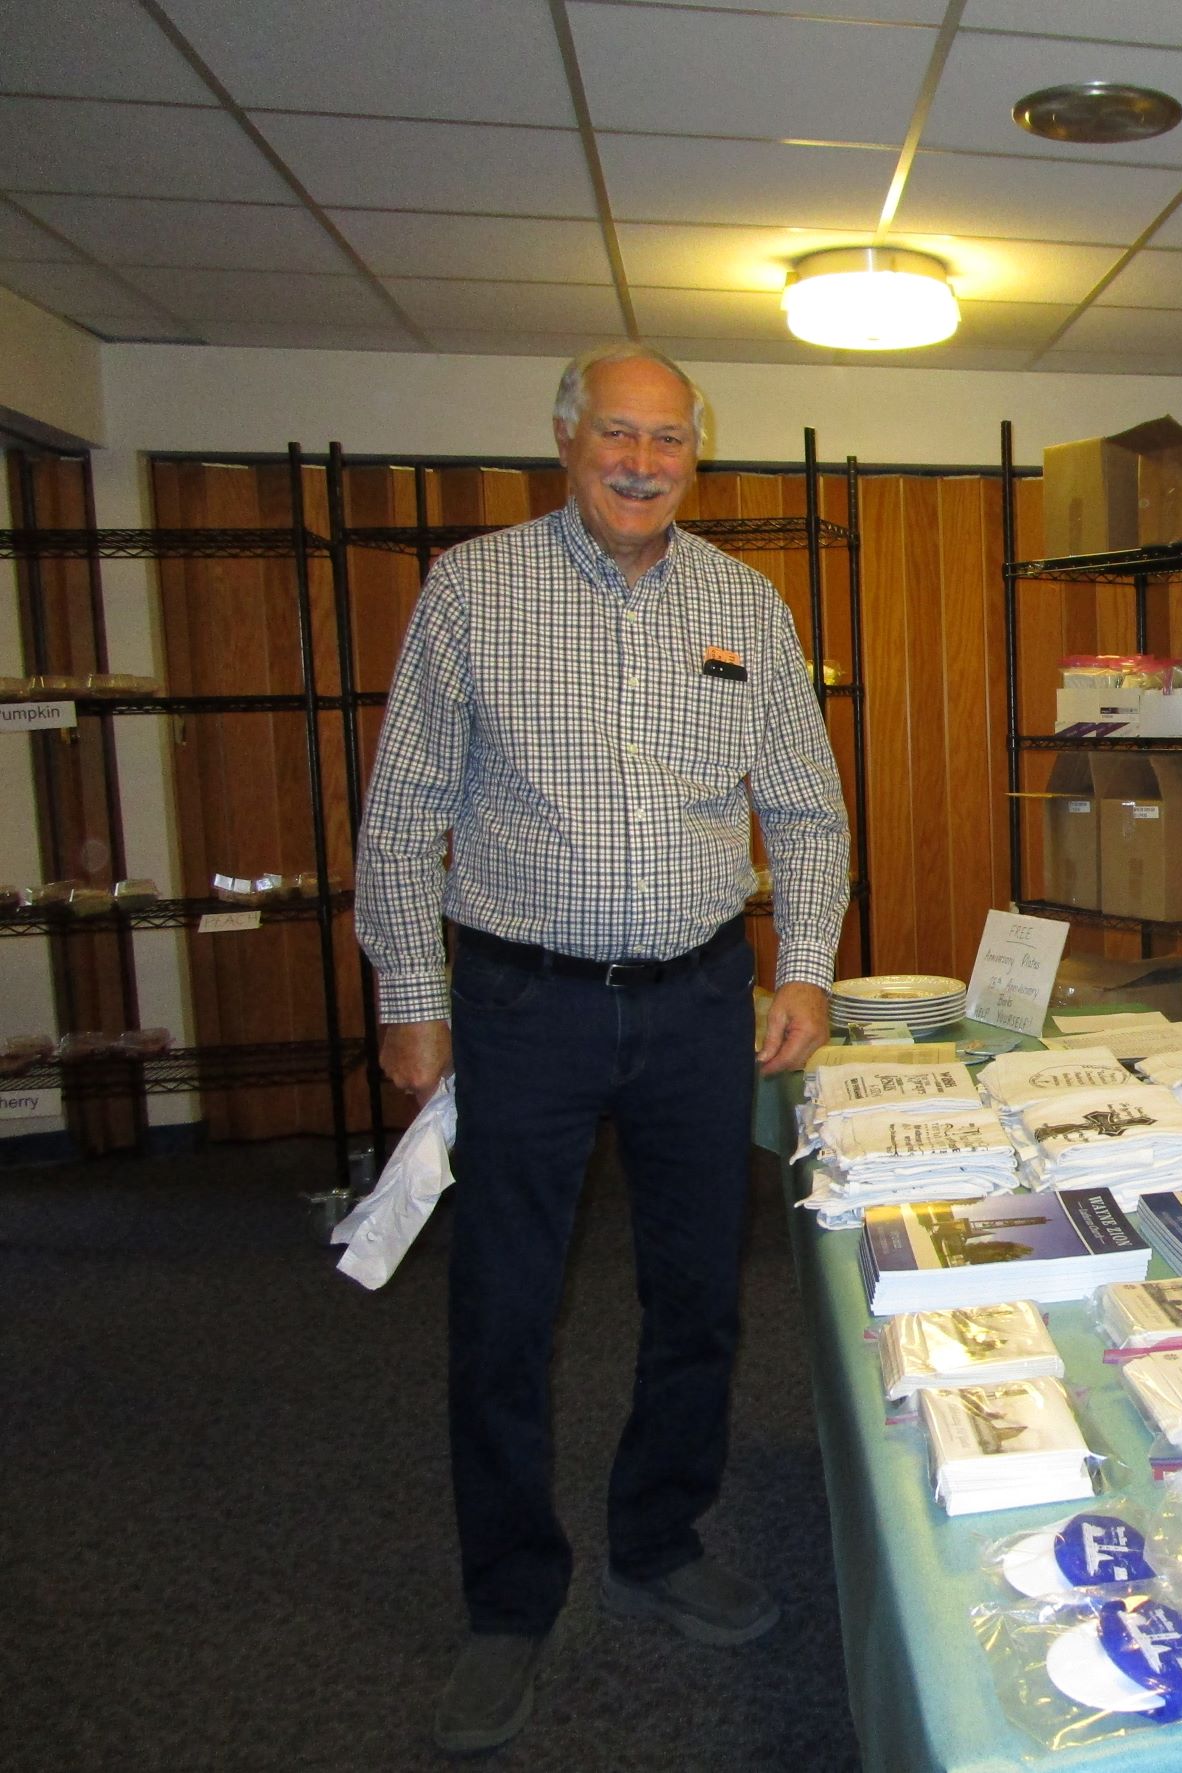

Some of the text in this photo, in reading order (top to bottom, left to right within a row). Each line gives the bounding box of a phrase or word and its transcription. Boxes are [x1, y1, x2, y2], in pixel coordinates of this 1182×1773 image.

[1009, 924, 1034, 940] FREE
[1088, 1195, 1133, 1247] WAYNE ZION
